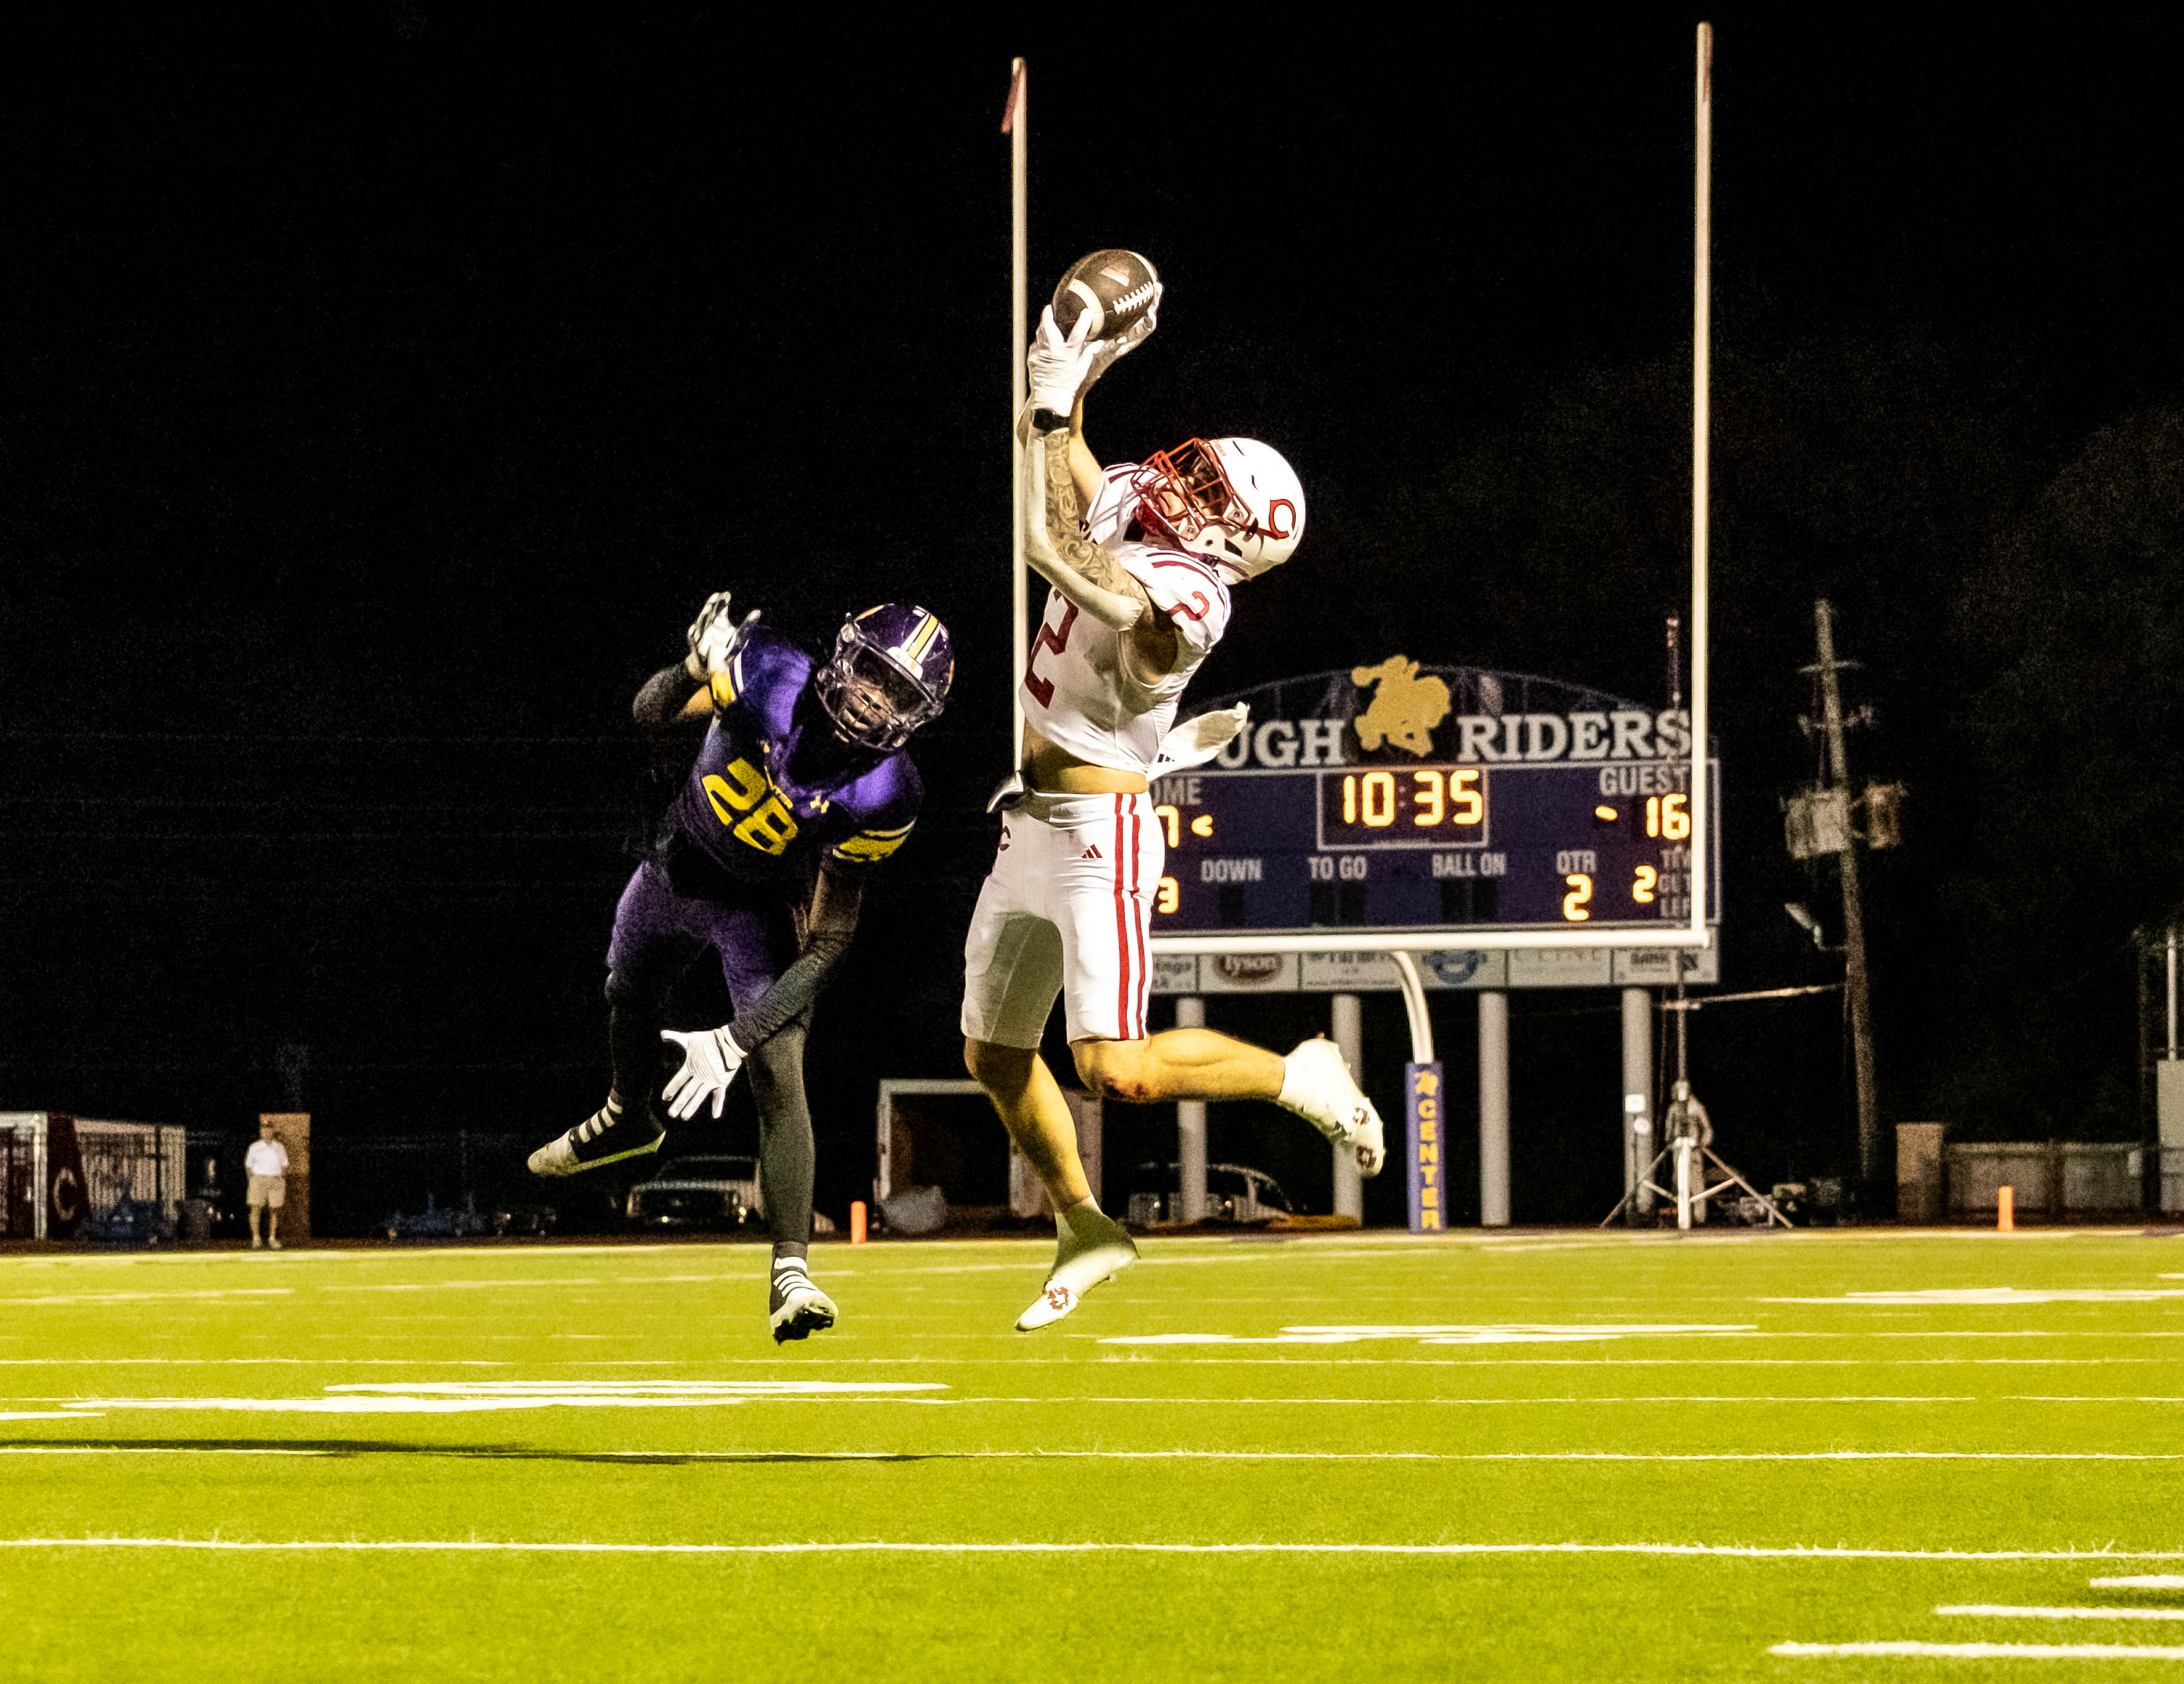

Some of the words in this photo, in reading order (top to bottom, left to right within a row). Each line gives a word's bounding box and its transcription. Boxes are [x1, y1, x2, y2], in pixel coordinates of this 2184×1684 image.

[1168, 591, 1210, 621] 2
[1024, 587, 1079, 710] 2
[1216, 718, 1345, 768] UGH
[1457, 709, 1691, 763] RIDERS
[1599, 765, 1690, 796] GUEST
[1646, 793, 1690, 840] 16
[1200, 858, 1263, 883] DOWN
[1308, 857, 1333, 879] TO
[1339, 856, 1367, 879] GO
[1432, 854, 1476, 878] BALL
[1480, 853, 1506, 876] ON
[1556, 850, 1597, 875] QTR
[1563, 873, 1593, 920] 2
[1633, 865, 1657, 903] 2
[1418, 1099, 1441, 1230] CENTER
